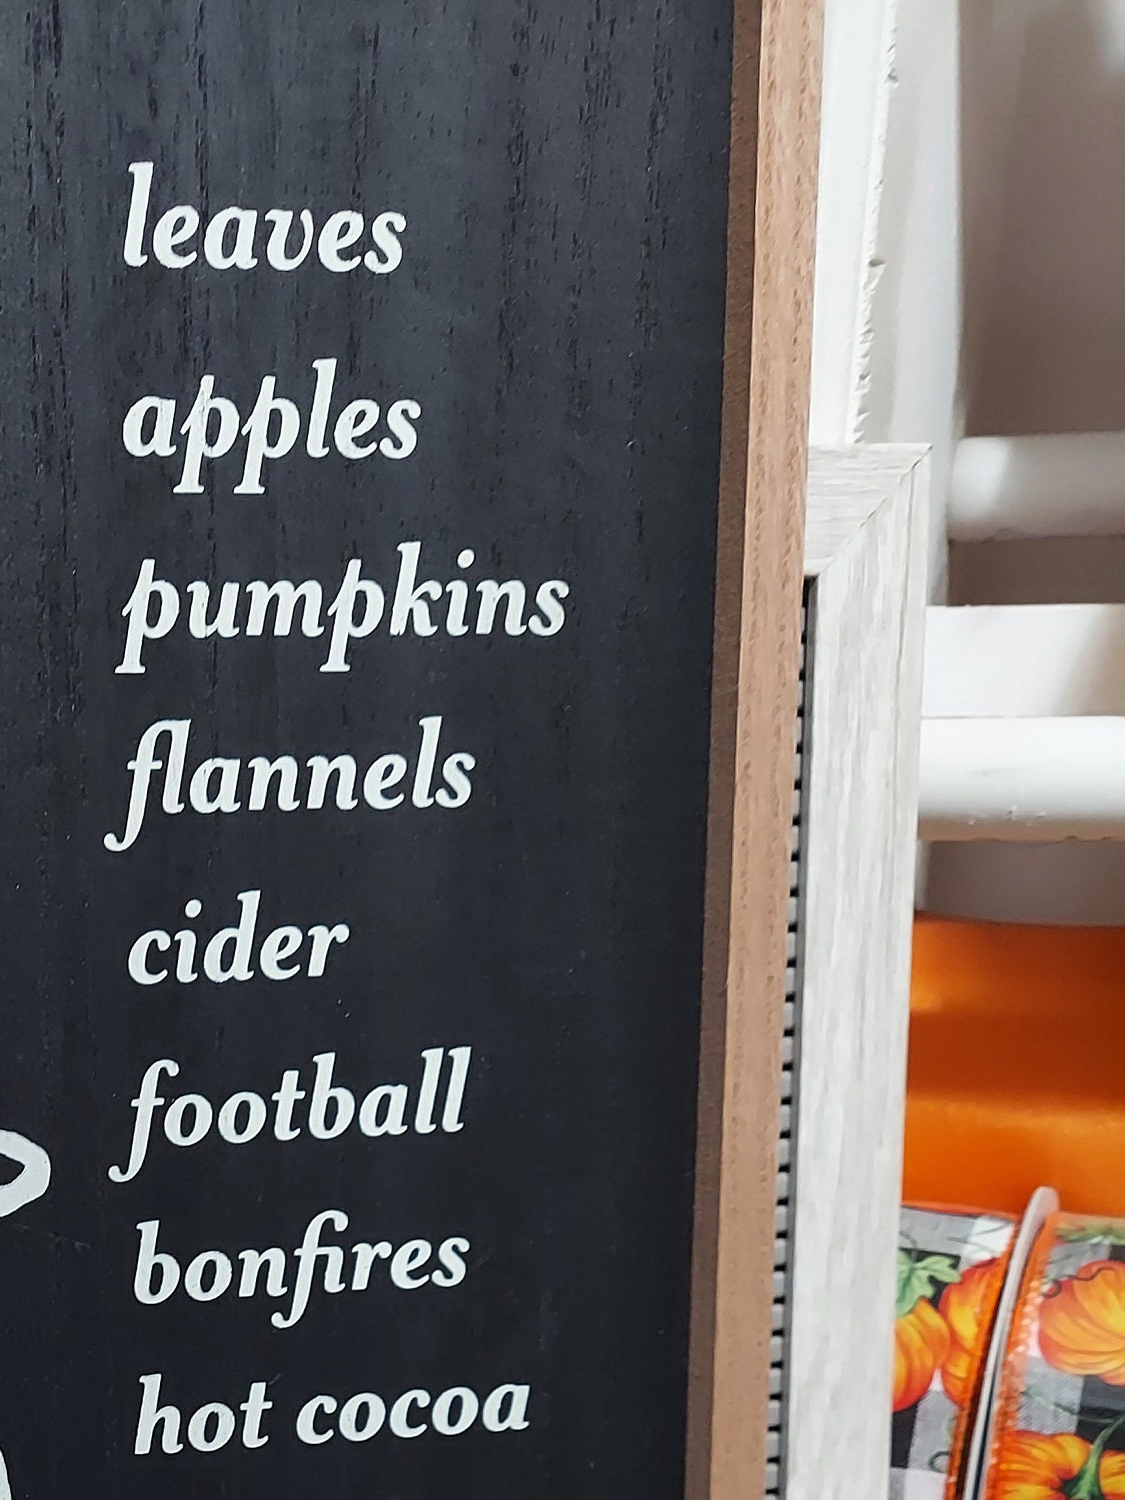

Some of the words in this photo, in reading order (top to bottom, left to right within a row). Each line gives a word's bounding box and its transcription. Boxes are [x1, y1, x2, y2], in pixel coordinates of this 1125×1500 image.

[124, 162, 406, 274] leaves
[123, 358, 421, 494] apples
[115, 541, 569, 673] pumpkins
[104, 716, 475, 851] flannels
[128, 890, 349, 984] cider
[109, 1047, 471, 1182] football
[134, 1210, 469, 1328] bonfires
[135, 1374, 272, 1454] hot
[297, 1384, 529, 1444] cocoa
